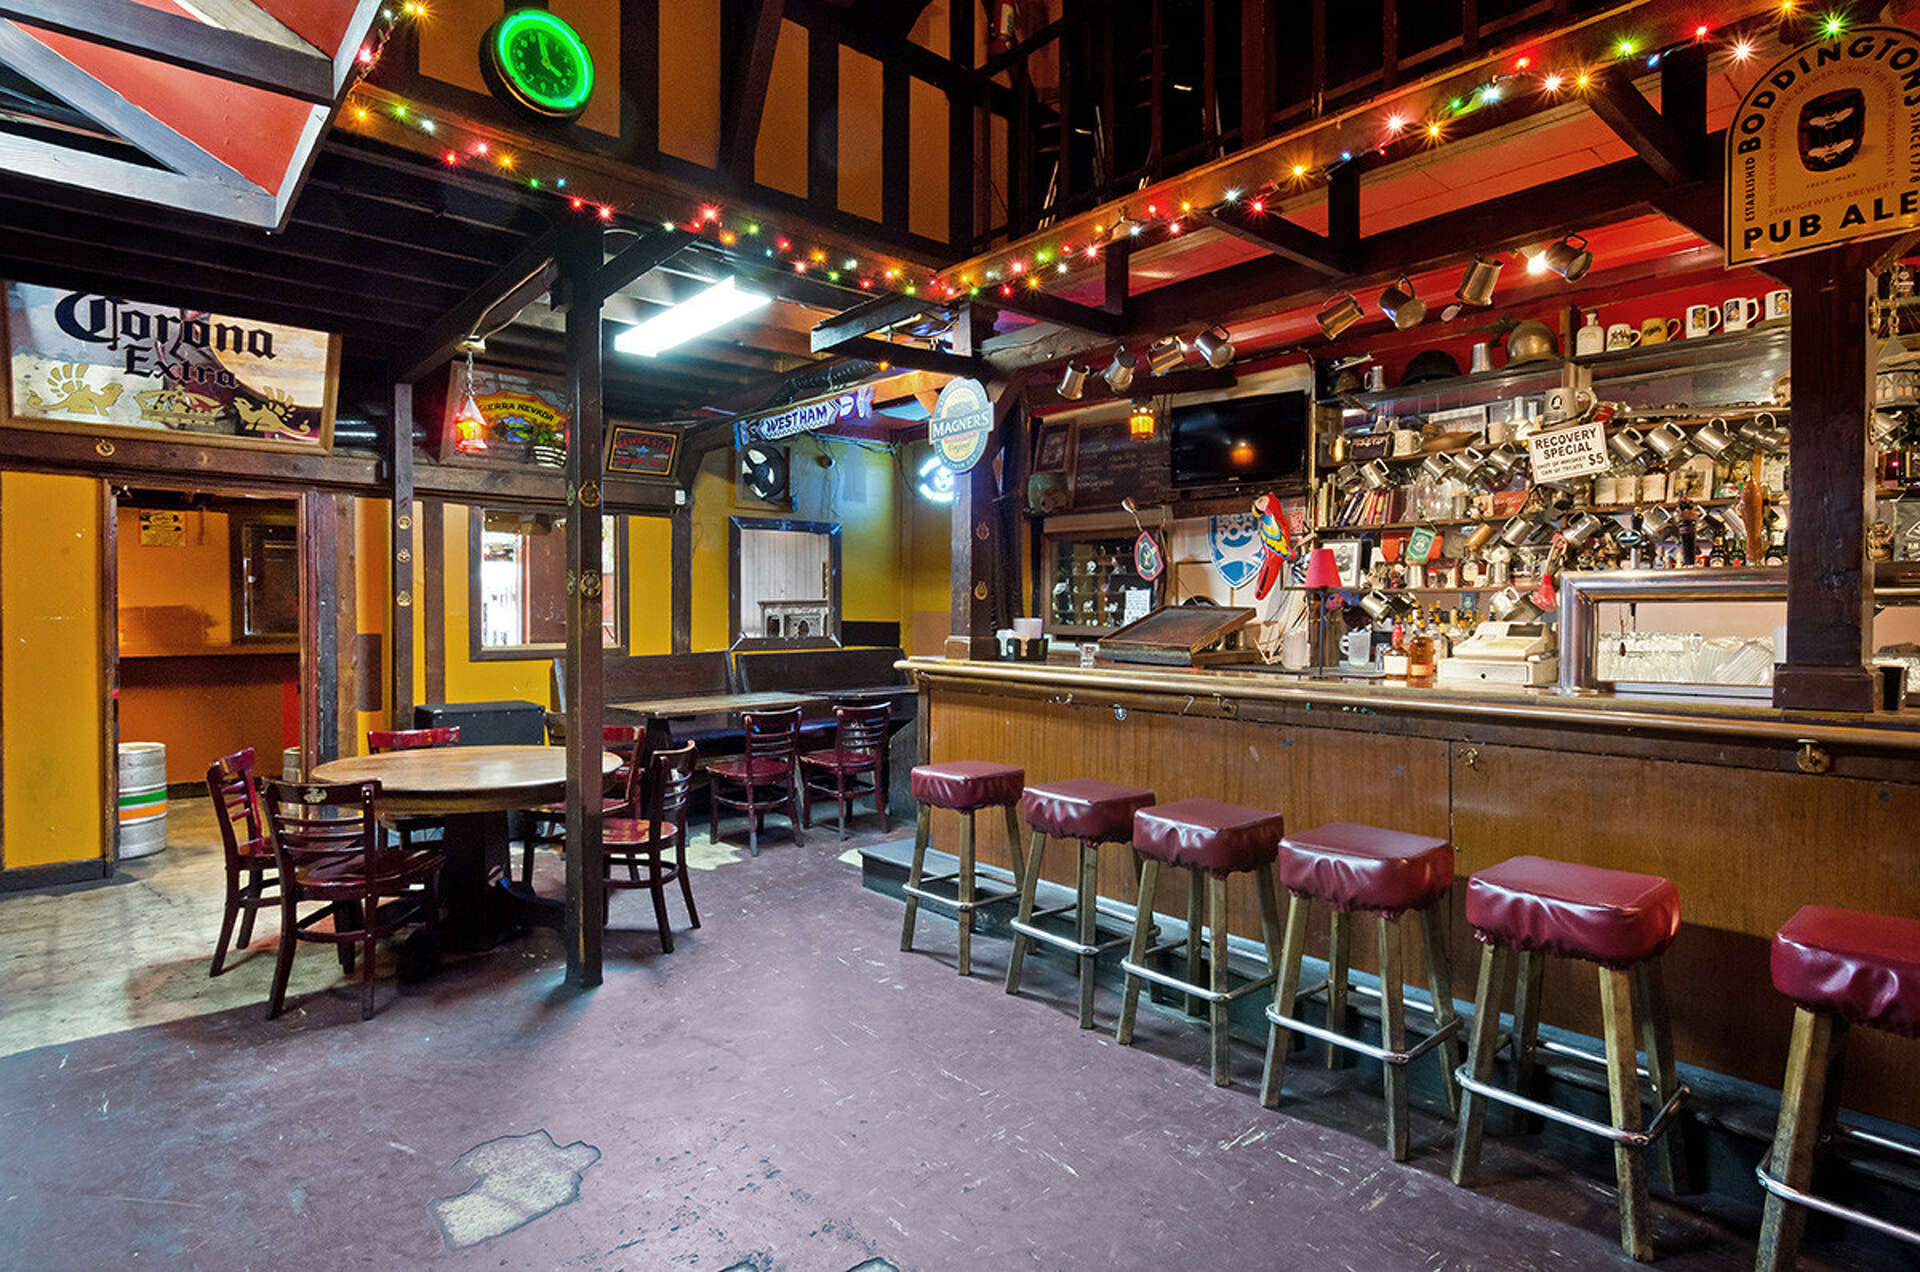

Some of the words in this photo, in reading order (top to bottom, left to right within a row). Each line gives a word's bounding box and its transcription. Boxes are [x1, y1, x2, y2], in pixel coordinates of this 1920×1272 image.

[1738, 36, 1920, 155] BODDINGTONS
[1744, 157, 1756, 222] ESTABLISHED
[1769, 193, 1844, 217] STRANGEWAYS
[1847, 181, 1897, 197] BREWERY
[1744, 214, 1822, 250] PUB
[1839, 190, 1919, 229] ALE
[54, 290, 277, 360] Corona
[123, 344, 240, 389] Extra
[517, 403, 555, 422] NEVADA
[932, 413, 989, 439] MAGNERS
[1535, 427, 1597, 450] RECOVERY
[1543, 441, 1593, 460] SPECIAL
[1588, 452, 1604, 466] $5
